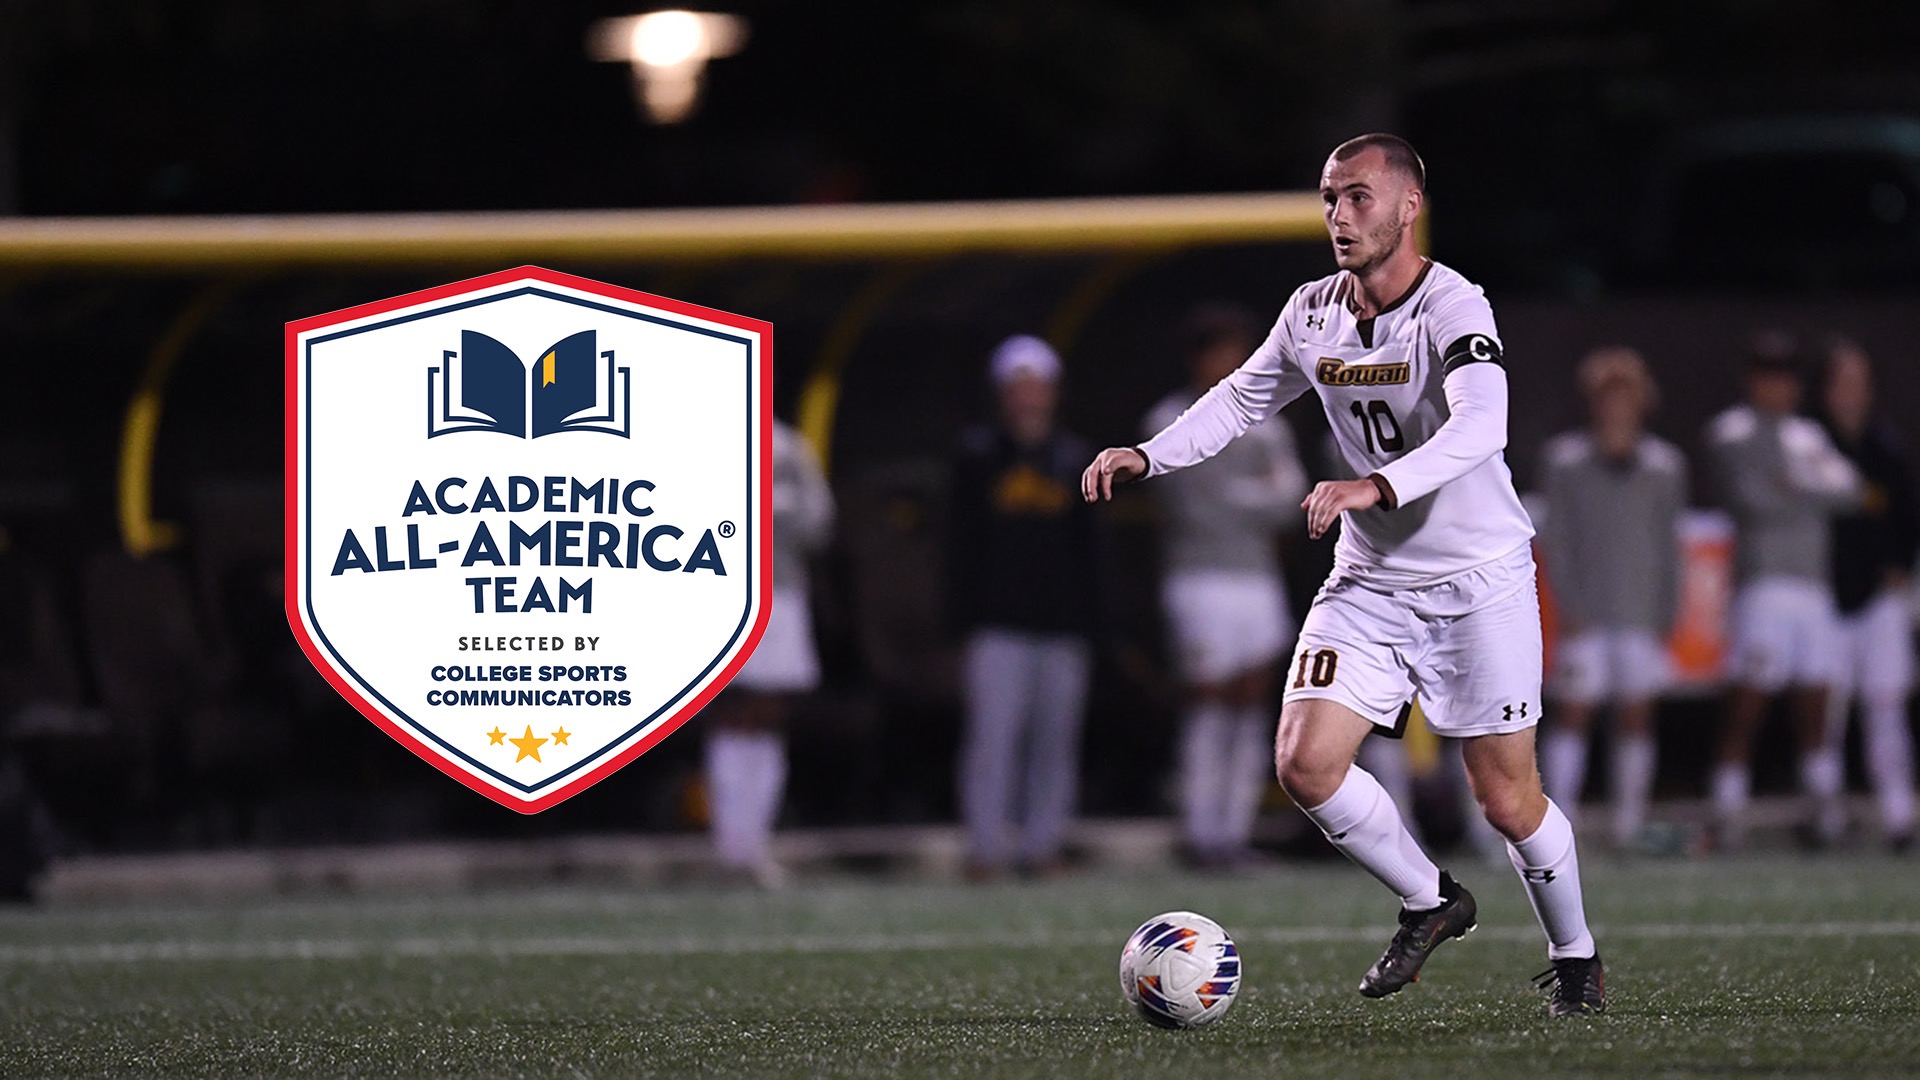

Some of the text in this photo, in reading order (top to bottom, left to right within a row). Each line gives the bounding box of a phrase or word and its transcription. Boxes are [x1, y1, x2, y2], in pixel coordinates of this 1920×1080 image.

[1469, 335, 1493, 361] C
[1316, 357, 1410, 386] Rowan
[1350, 400, 1404, 454] 10
[1293, 649, 1339, 689] 10
